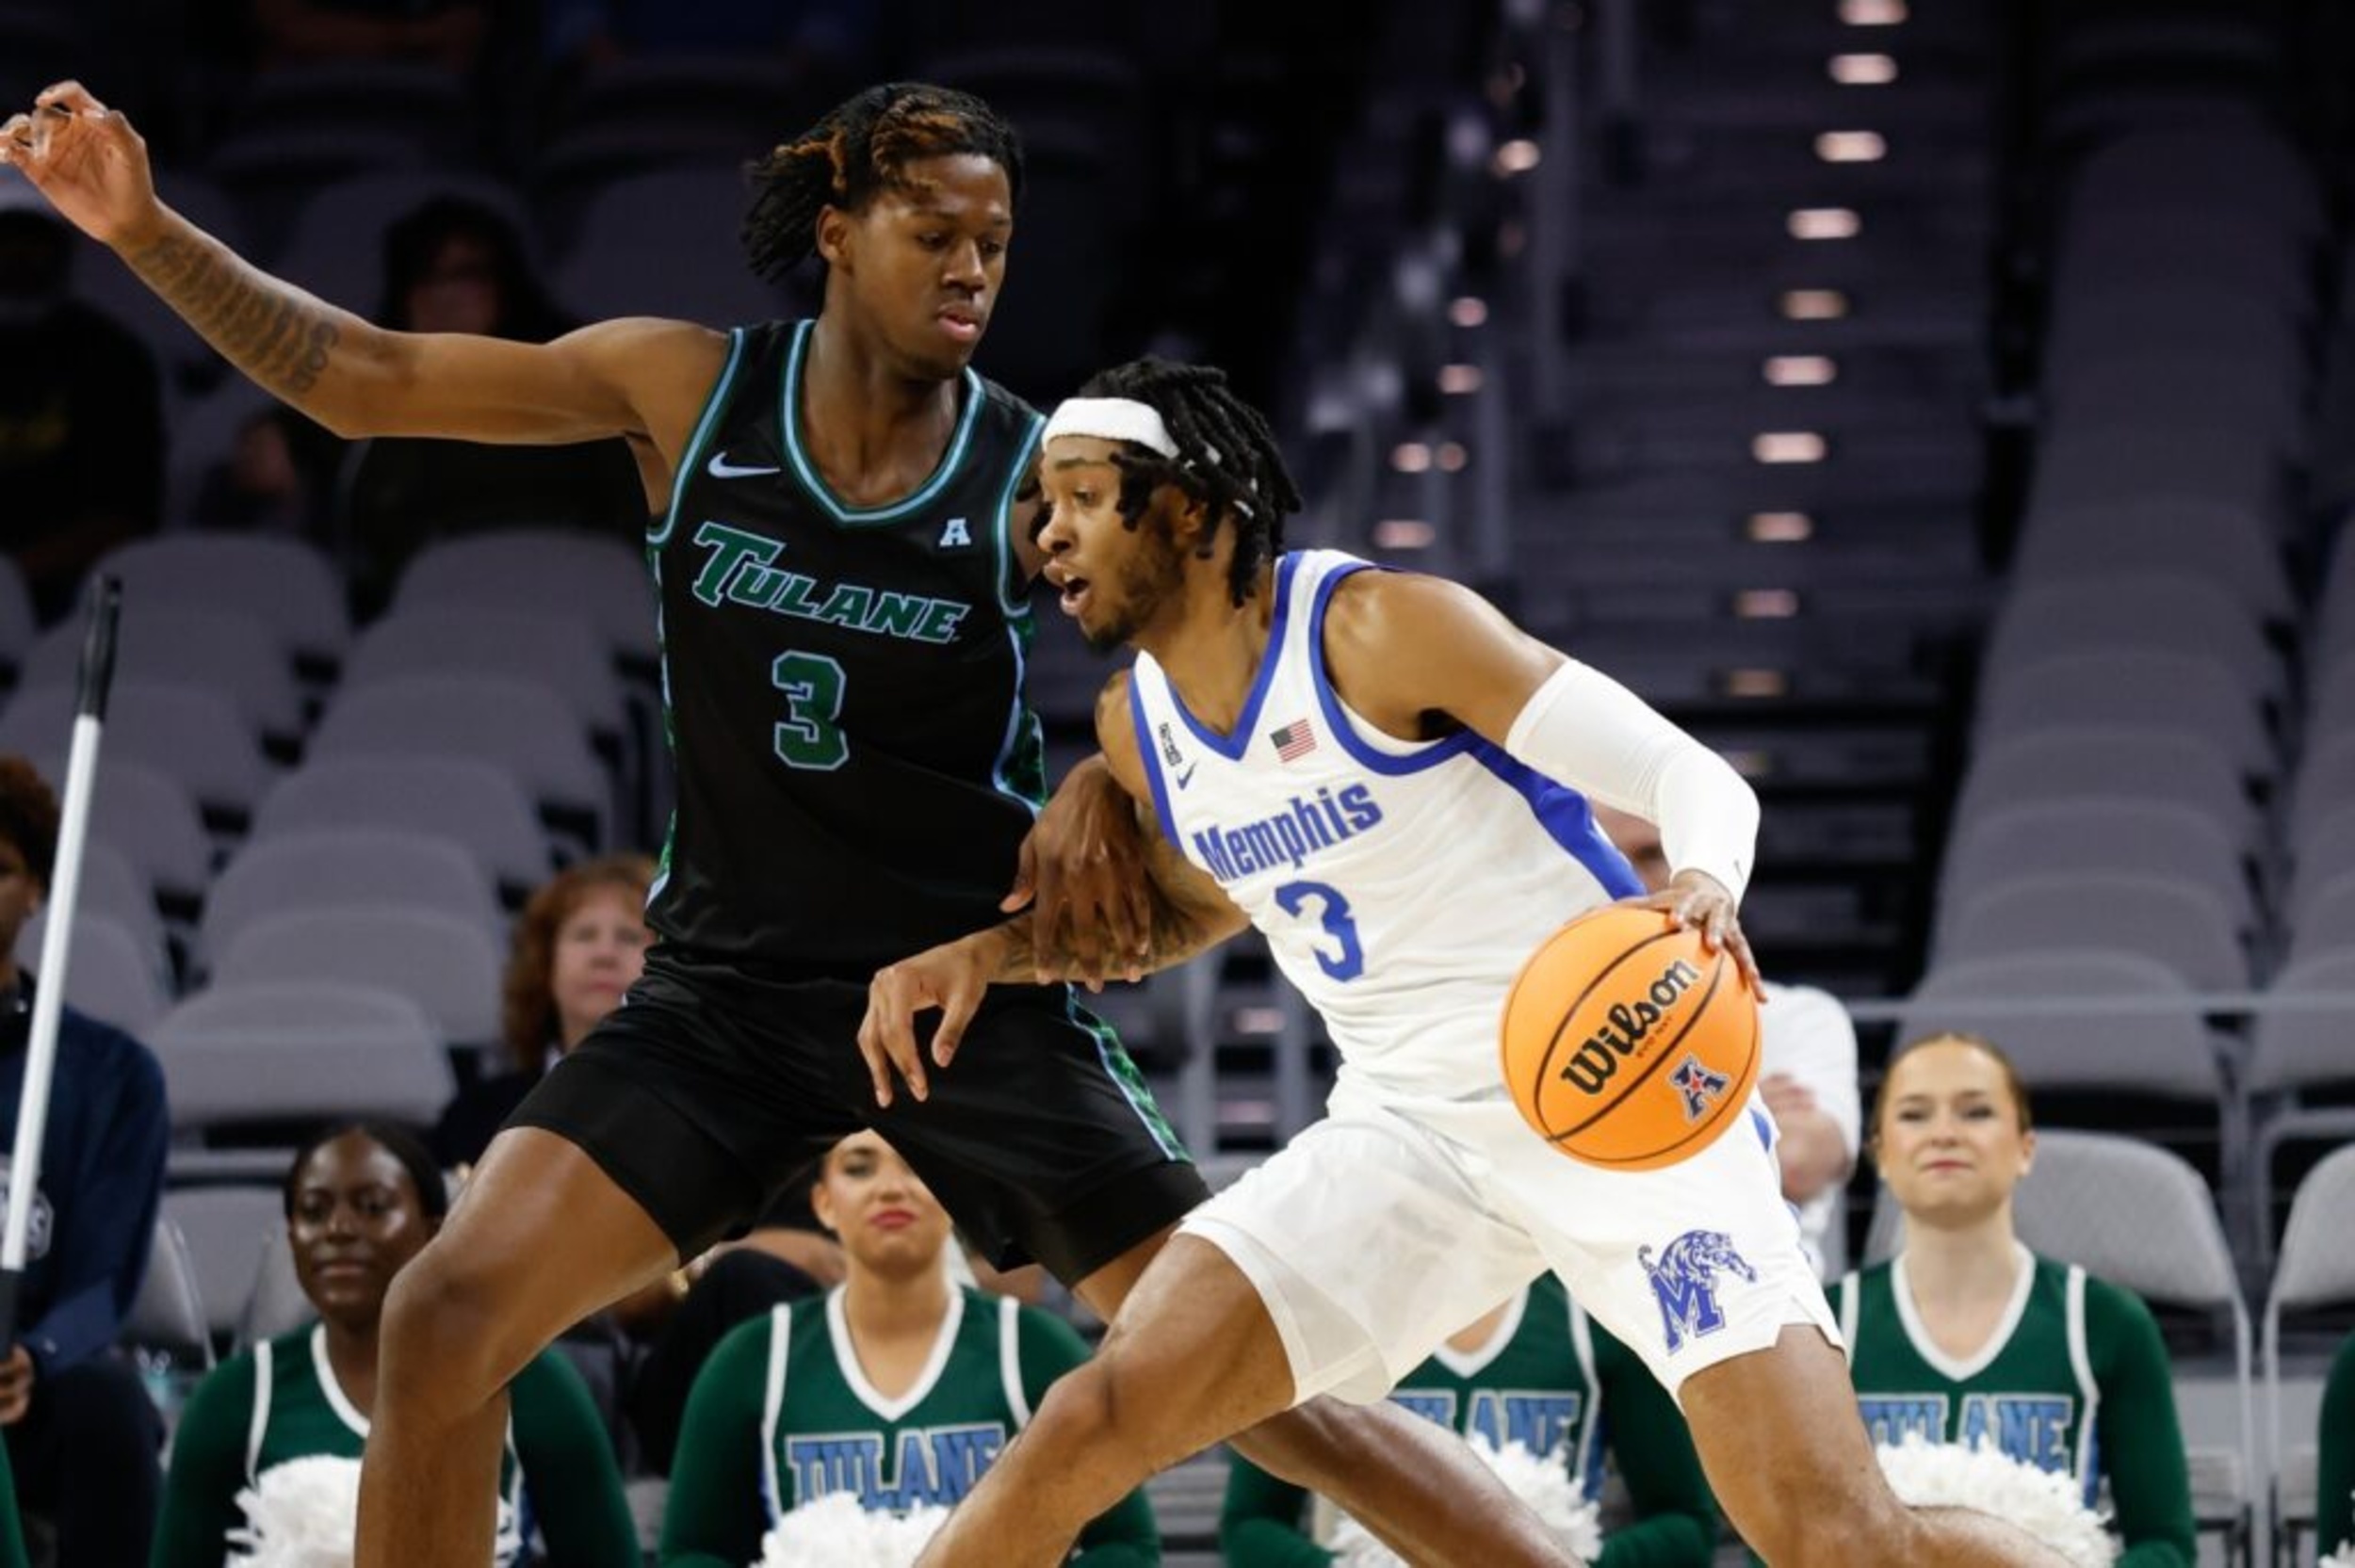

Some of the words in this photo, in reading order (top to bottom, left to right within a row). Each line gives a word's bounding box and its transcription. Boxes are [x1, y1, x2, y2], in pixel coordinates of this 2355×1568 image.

[692, 521, 971, 644] TULANE
[772, 650, 849, 771] 3
[1193, 783, 1383, 882] Memphis
[1275, 880, 1363, 982] 3
[1560, 960, 1699, 1095] Wilson
